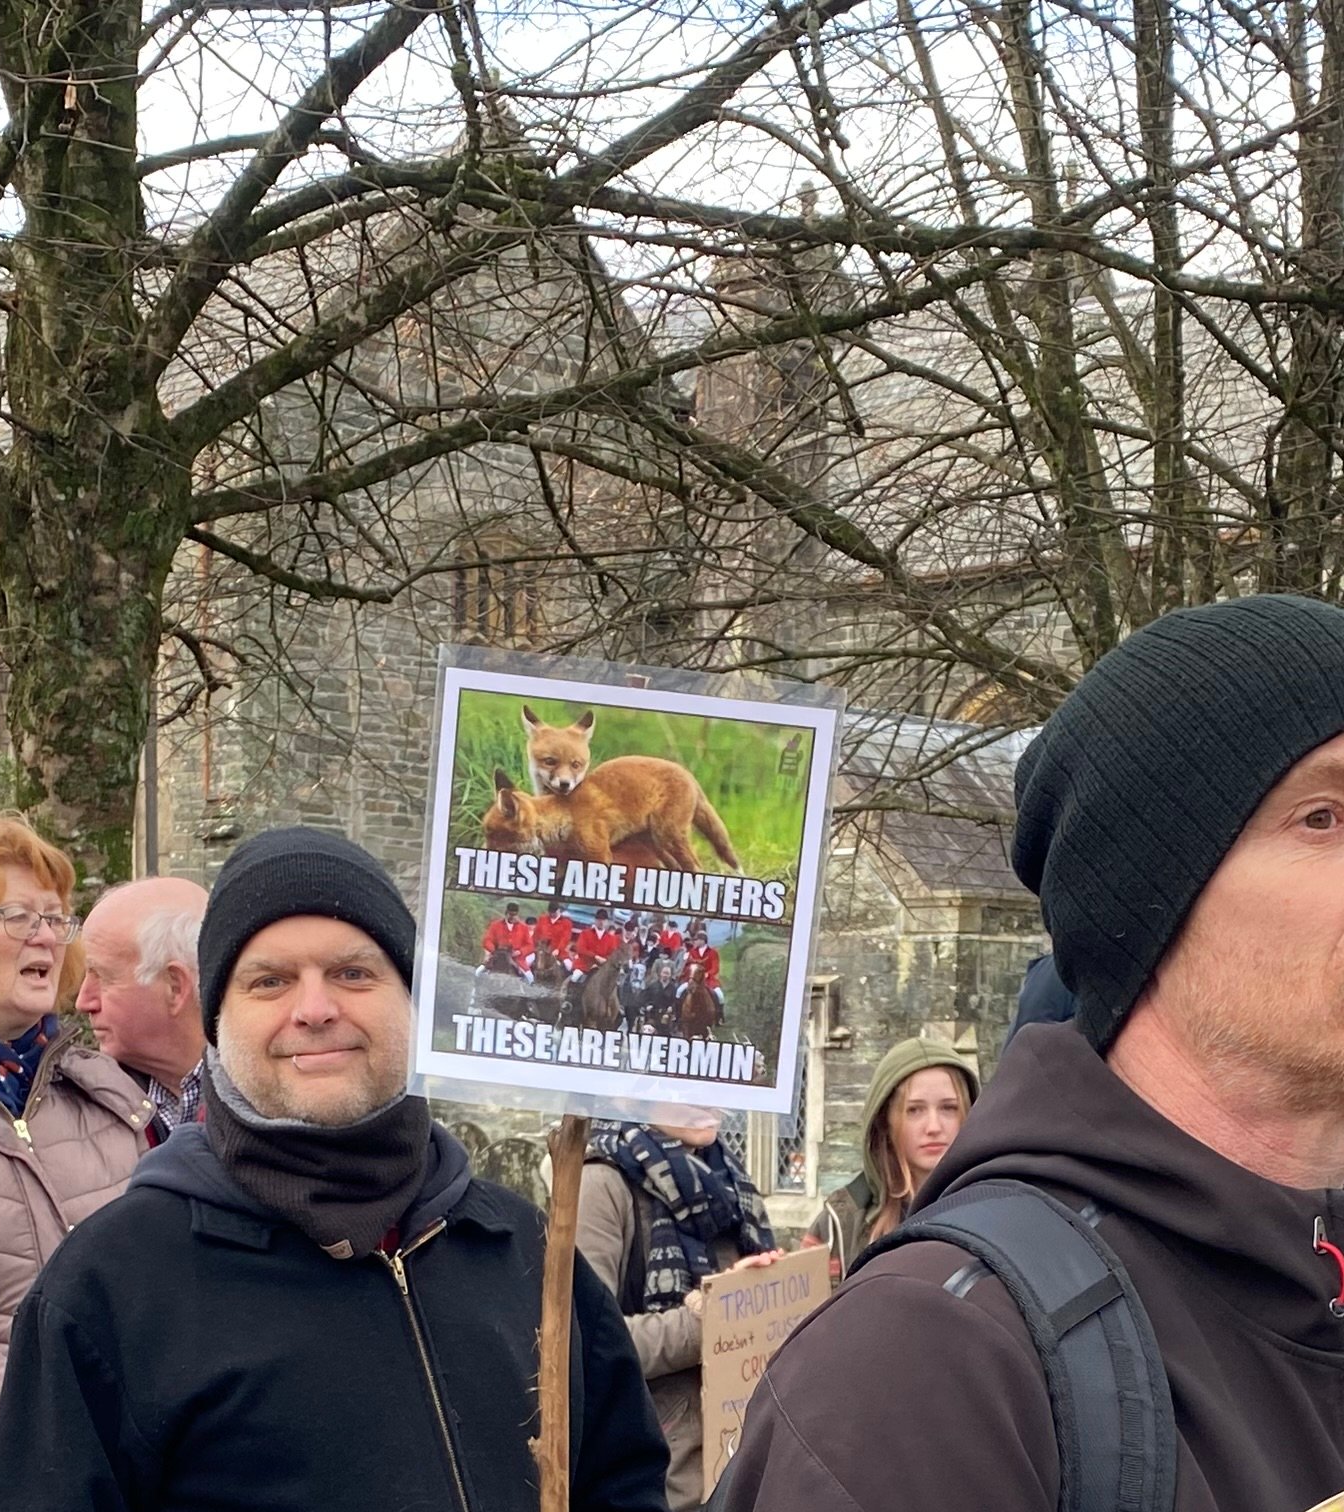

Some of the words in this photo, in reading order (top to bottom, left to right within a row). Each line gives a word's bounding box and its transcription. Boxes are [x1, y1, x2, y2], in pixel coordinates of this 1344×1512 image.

[454, 847, 558, 895] THESE
[561, 858, 628, 903] ARE
[632, 866, 787, 921] HUNTERS
[452, 1013, 555, 1061] THESE
[557, 1024, 622, 1069] ARE
[624, 1032, 756, 1083] VERMIN
[720, 1274, 810, 1322] TRADITION
[741, 1350, 775, 1383] CRU
